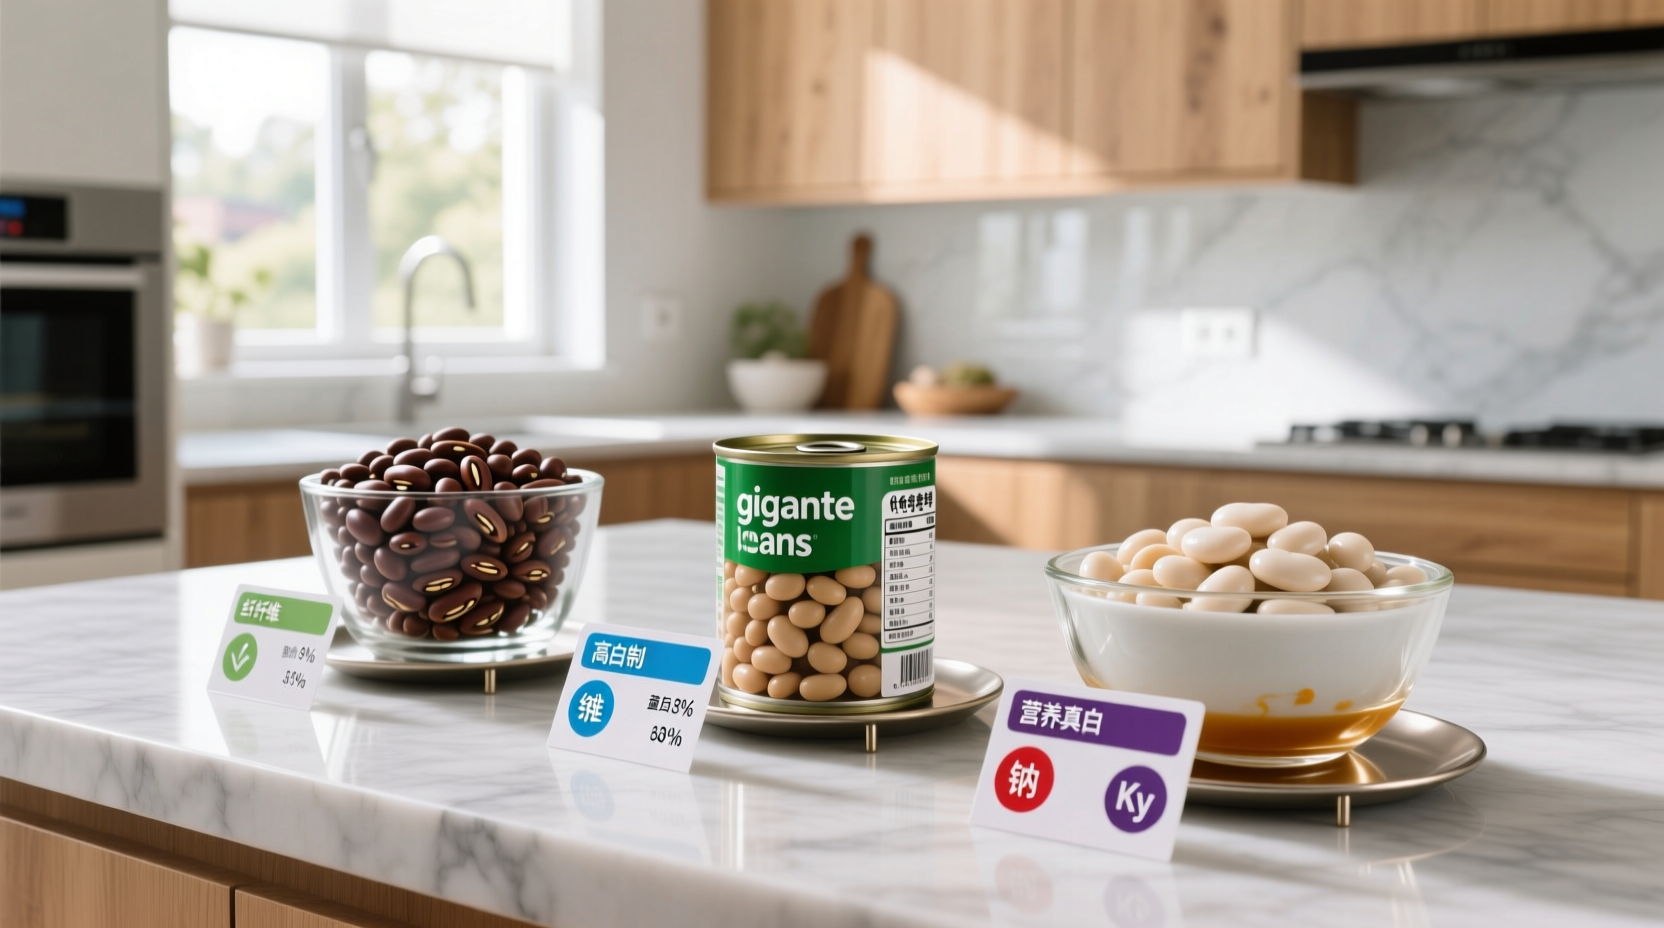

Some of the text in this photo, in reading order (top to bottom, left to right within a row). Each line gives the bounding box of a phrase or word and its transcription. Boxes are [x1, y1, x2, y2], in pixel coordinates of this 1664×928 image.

[736, 485, 855, 528] gigante
[591, 639, 647, 670] 高白制
[1019, 699, 1104, 736] 营养真白
[1008, 759, 1040, 800] 钠
[1115, 780, 1156, 824] Ky
